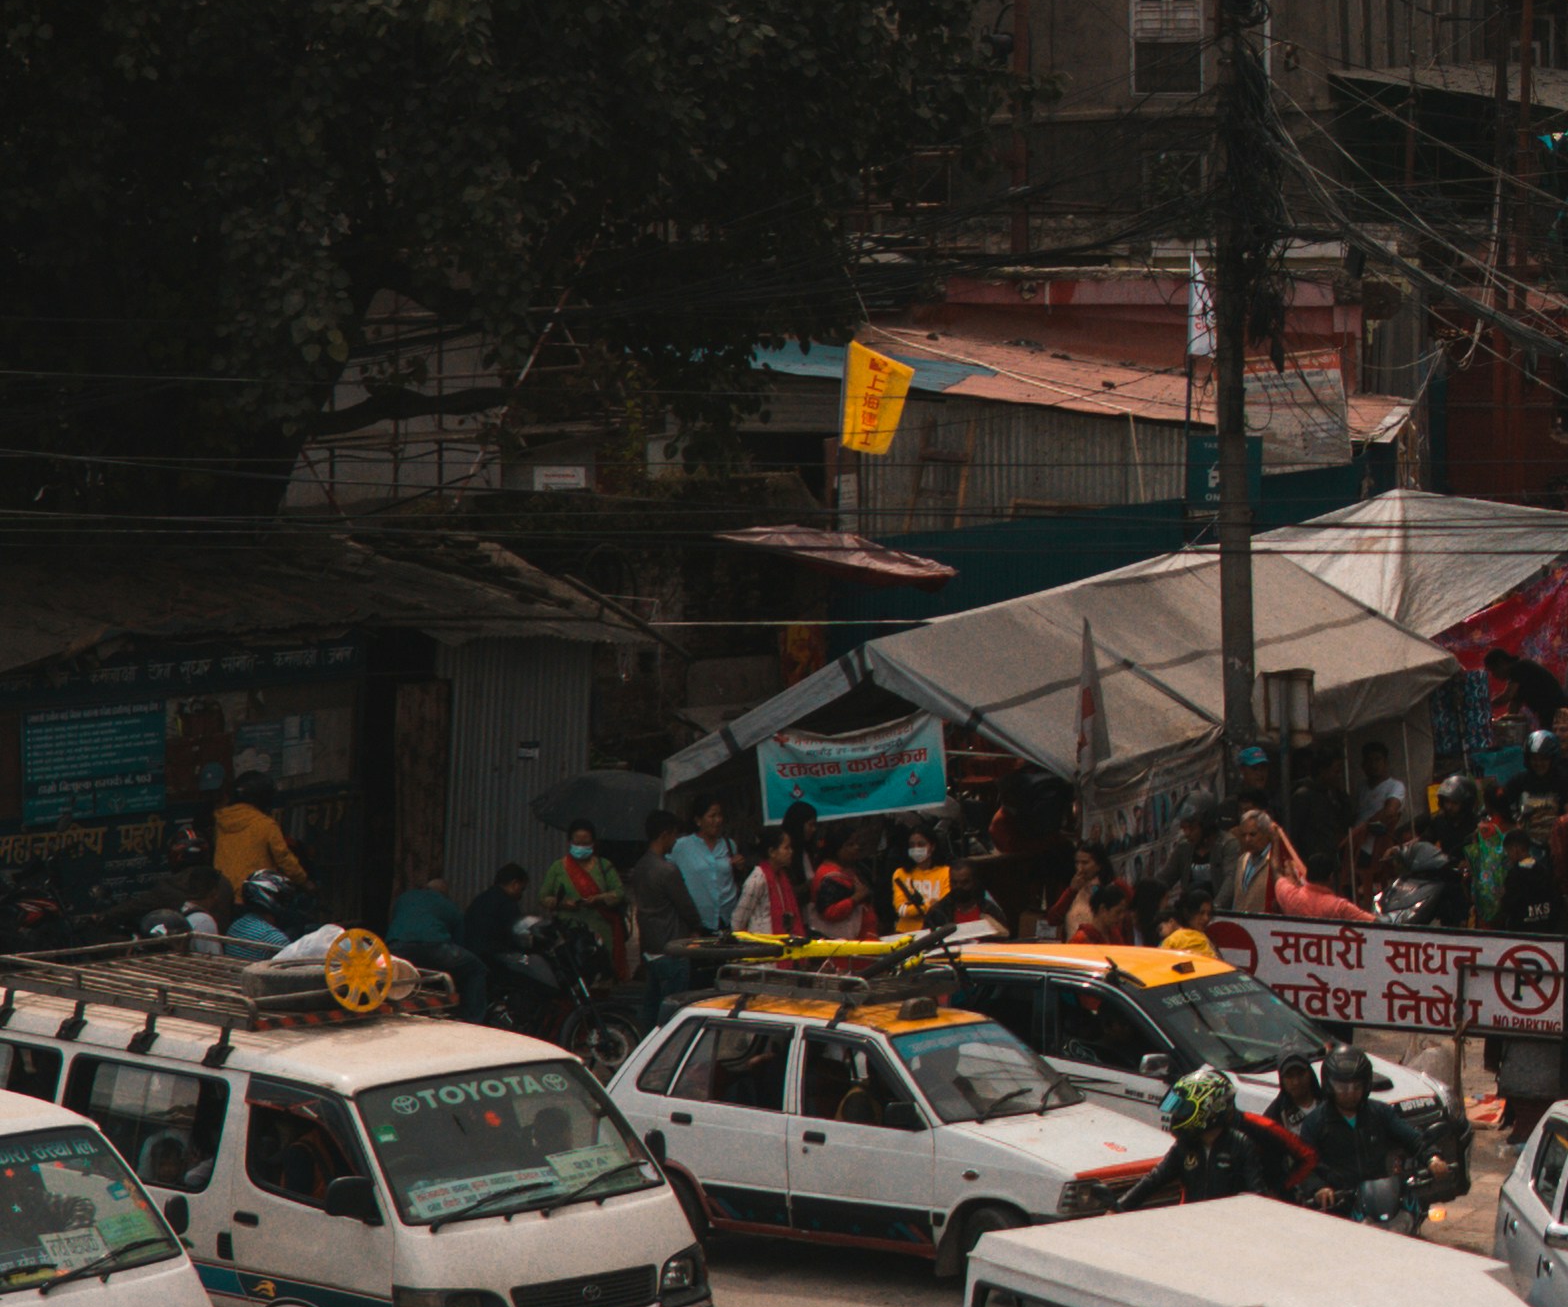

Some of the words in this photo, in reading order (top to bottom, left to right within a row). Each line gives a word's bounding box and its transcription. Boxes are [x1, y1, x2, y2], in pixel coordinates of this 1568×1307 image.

[1270, 926, 1366, 969] सवारी
[1384, 940, 1483, 977] साधन
[1492, 1014, 1508, 1028] NO
[417, 1074, 544, 1109] TOYOTA
